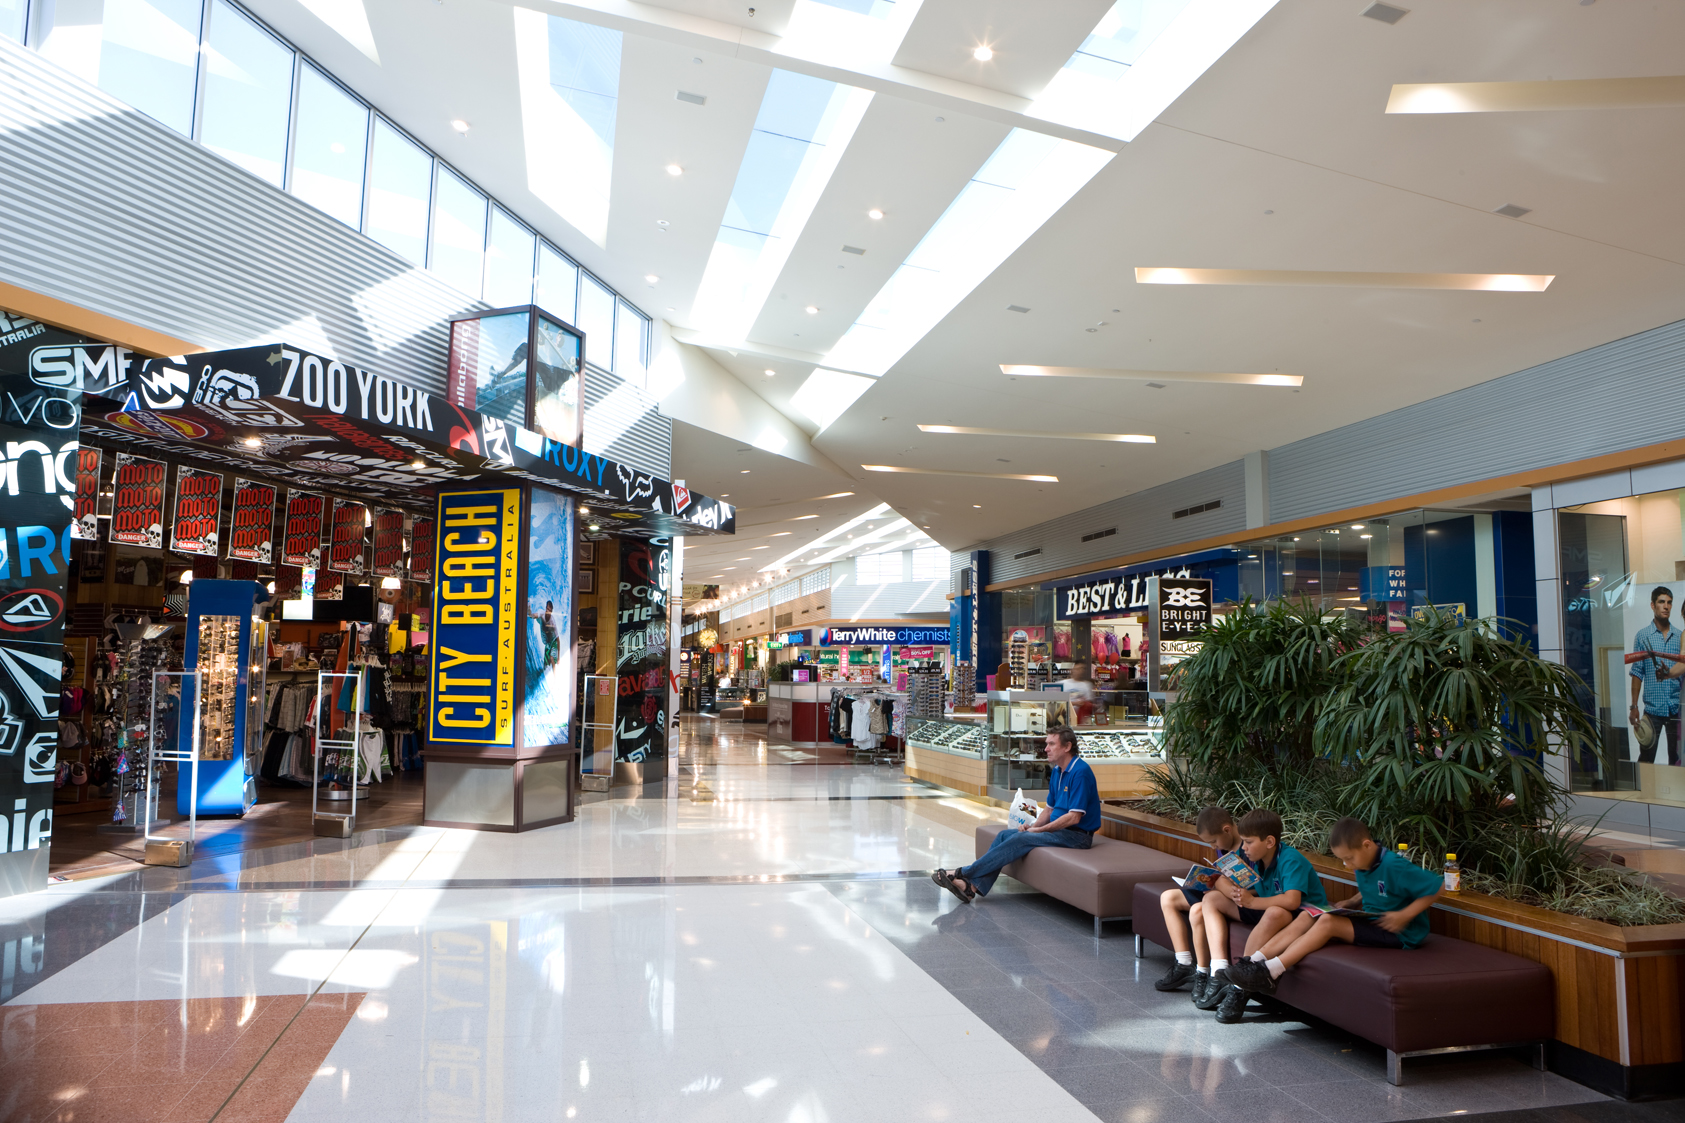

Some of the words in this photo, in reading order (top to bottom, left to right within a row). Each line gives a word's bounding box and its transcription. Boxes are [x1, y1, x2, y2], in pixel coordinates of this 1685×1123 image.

[0, 323, 46, 348] TRALIA
[273, 349, 347, 415] ZOO
[354, 367, 434, 432] YORK
[544, 437, 609, 487] ROXY
[119, 464, 163, 486] MOTO
[180, 476, 219, 496] MOTO
[117, 486, 162, 508] MOTO
[237, 488, 273, 506] MOTO
[289, 498, 321, 515] MOTO
[178, 498, 218, 518] MOTO
[235, 508, 271, 526] MOTO
[335, 506, 364, 523] MOTO
[115, 508, 160, 531] MOTO
[176, 518, 216, 539] MOTO
[288, 517, 320, 534] MOTO
[118, 534, 146, 542] DANGER
[233, 528, 269, 548] MOTO
[334, 525, 363, 542] MOTO
[286, 536, 318, 555] MOTO
[332, 543, 361, 560] MOTO
[441, 505, 497, 625] BEACH
[504, 504, 515, 648] AUSTRALIA
[1066, 583, 1115, 615] BEST
[1115, 584, 1126, 609] &
[1162, 610, 1207, 620] BRIGHT
[438, 646, 492, 729] CITY
[501, 666, 509, 729] SURF
